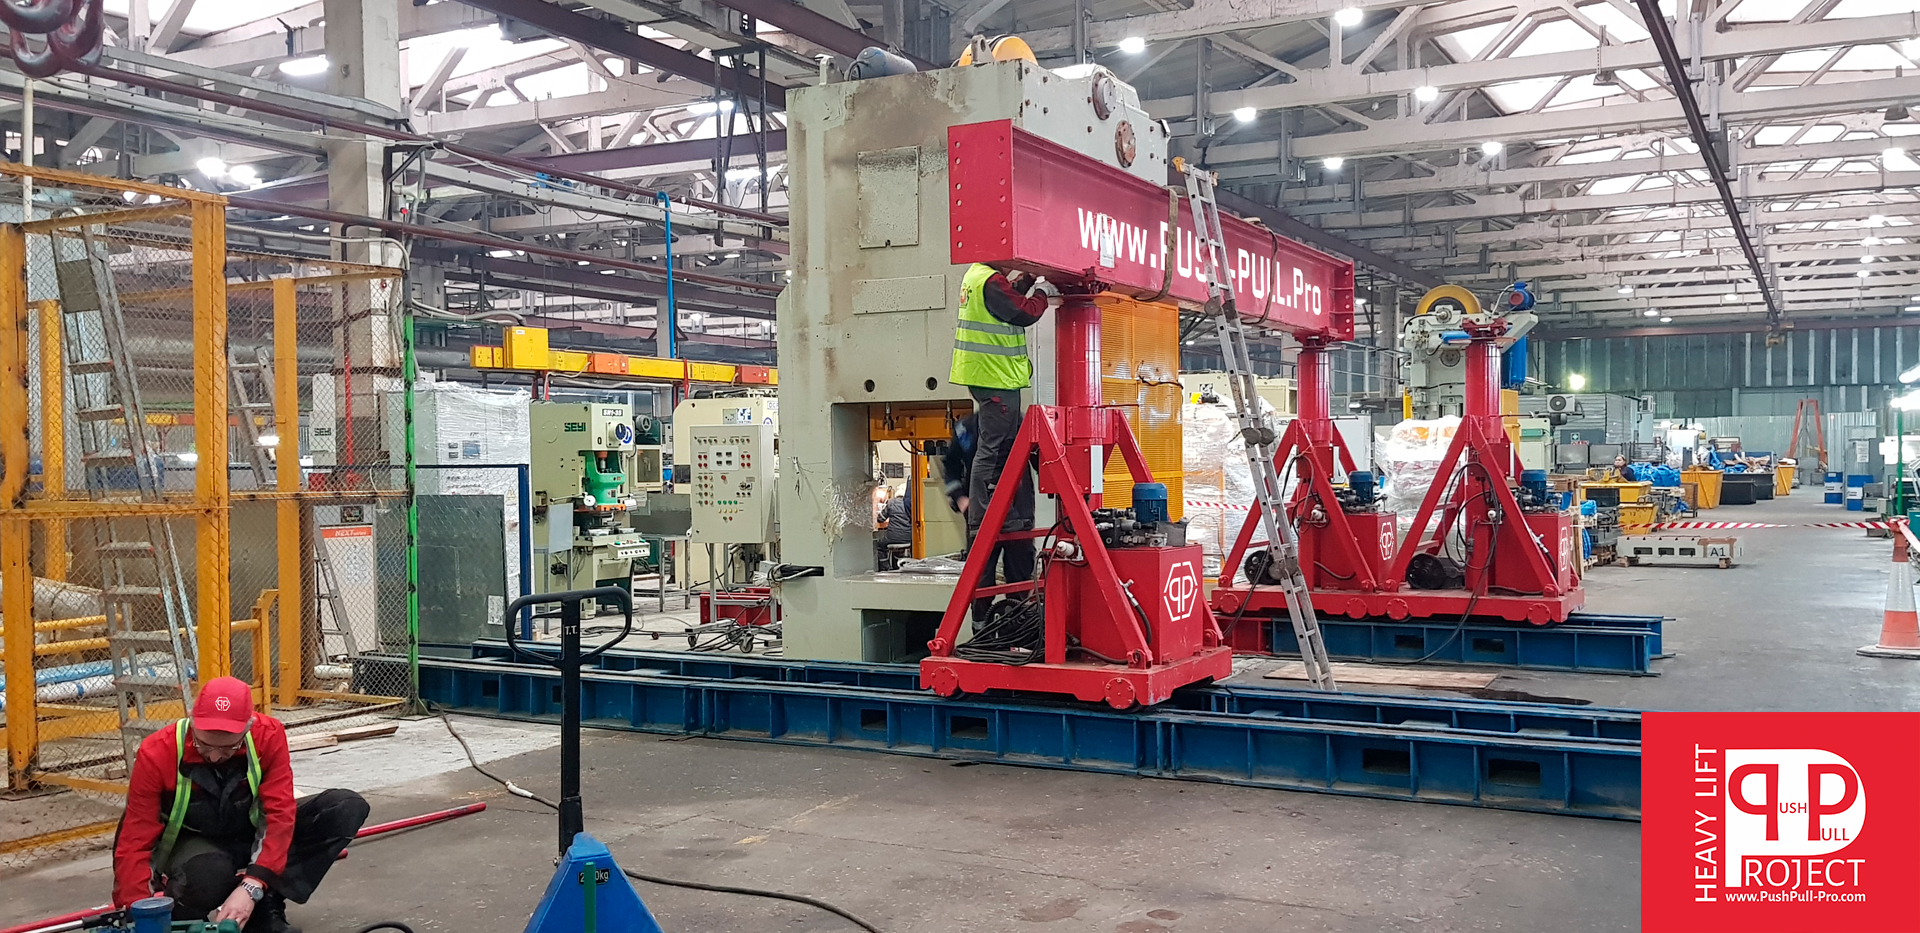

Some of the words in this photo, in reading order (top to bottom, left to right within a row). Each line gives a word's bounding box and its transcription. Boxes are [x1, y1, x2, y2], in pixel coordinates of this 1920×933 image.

[1078, 207, 1322, 316] www.PUS-PULL.Pro
[564, 422, 586, 432] SEYI
[1710, 547, 1726, 557] A1
